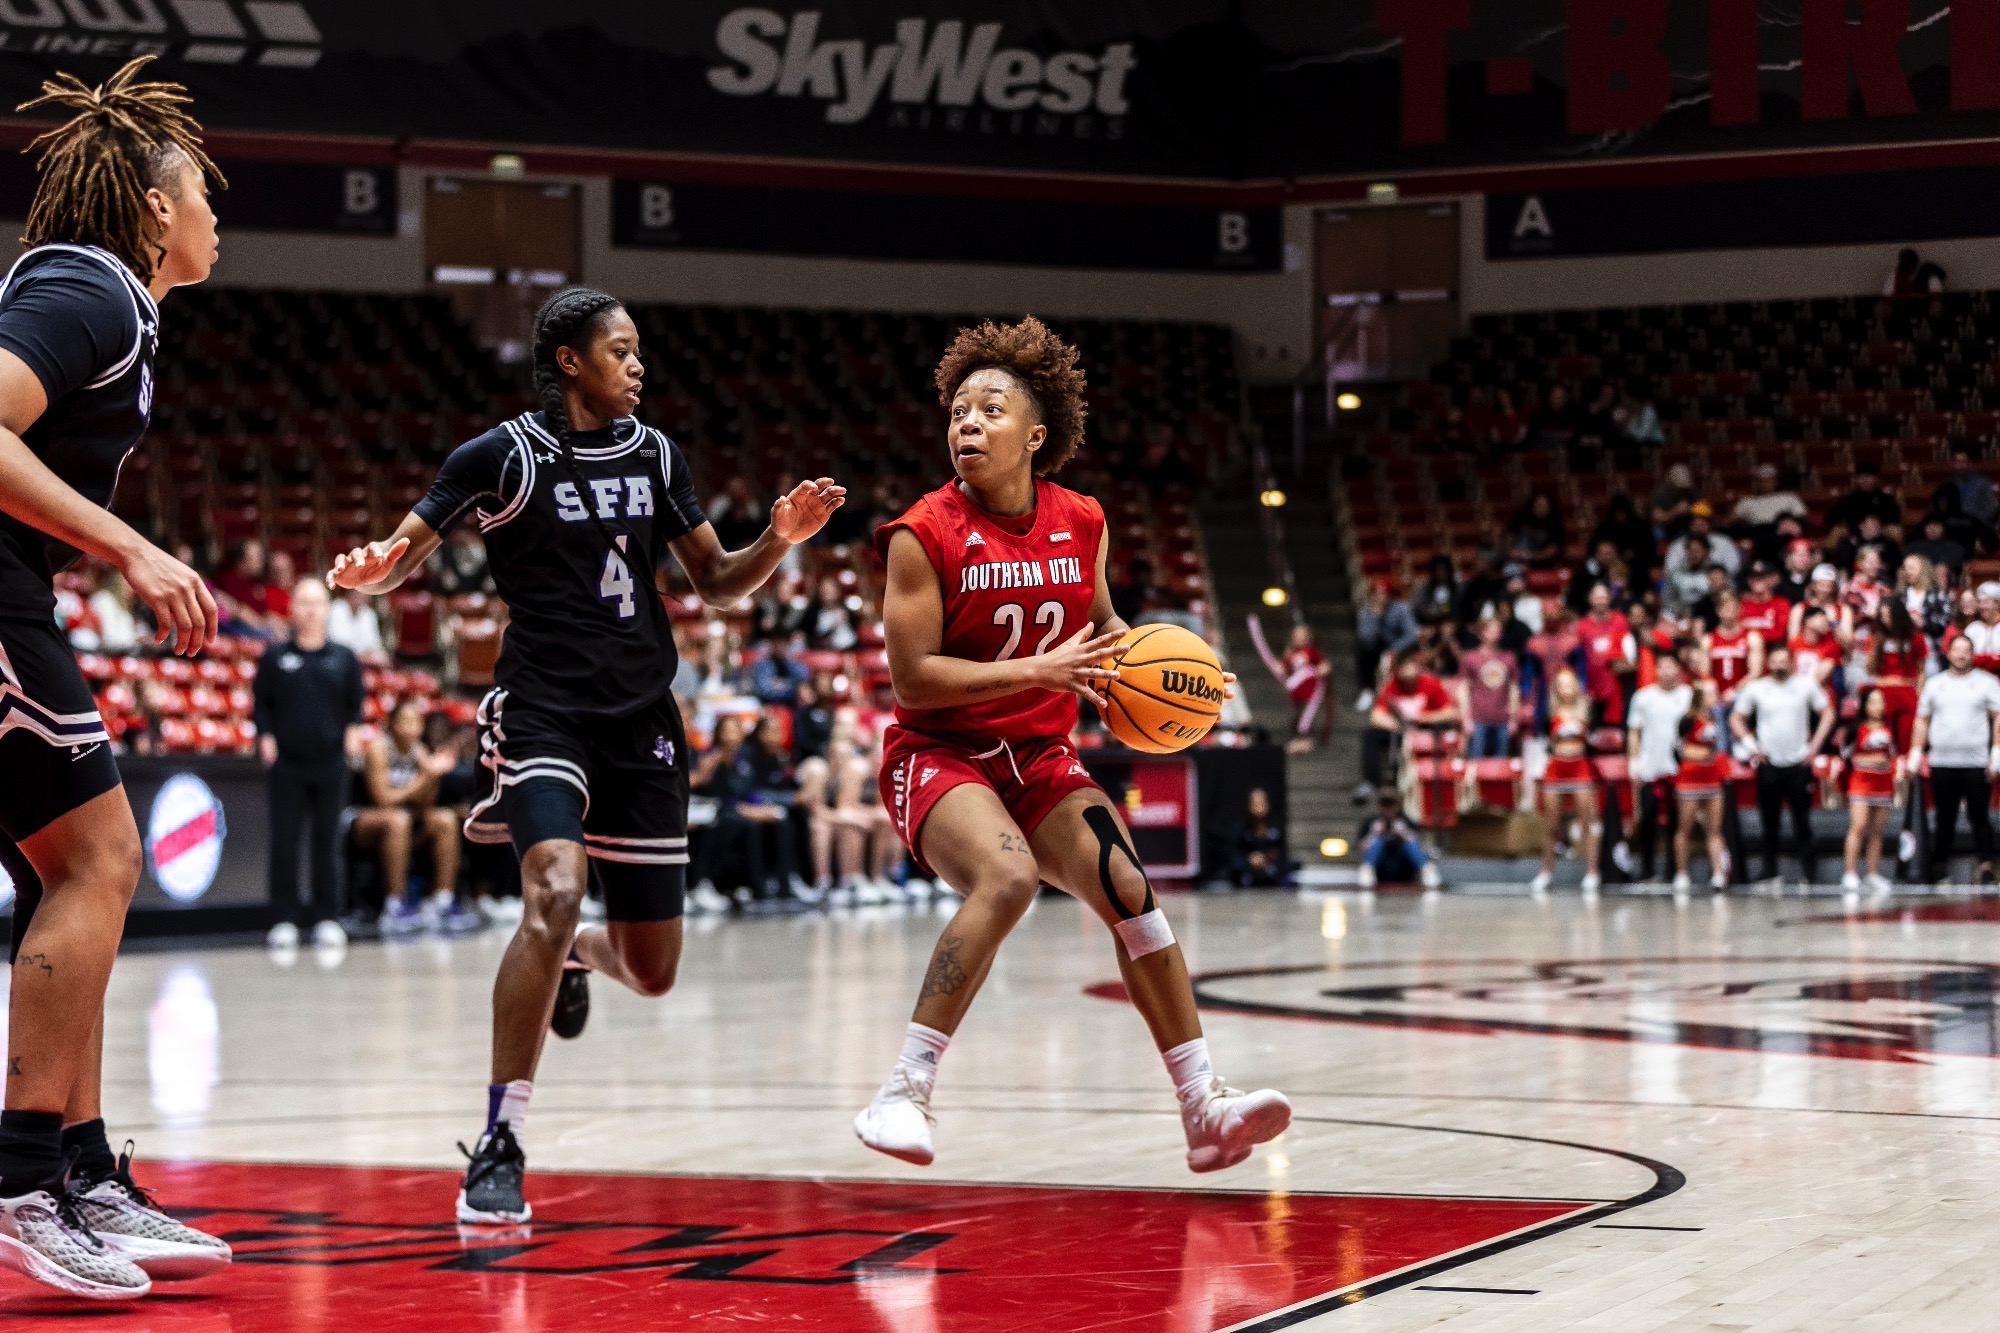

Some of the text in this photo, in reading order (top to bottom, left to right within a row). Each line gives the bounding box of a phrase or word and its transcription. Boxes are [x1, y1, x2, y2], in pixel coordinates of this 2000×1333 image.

[705, 7, 1139, 125] SkyWest
[344, 170, 379, 214] B
[640, 185, 675, 229] B
[1217, 210, 1250, 253] B
[1513, 196, 1553, 237] A
[553, 475, 655, 522] SFA
[599, 532, 636, 619] 4
[960, 561, 1045, 593] SOUTHERN
[992, 600, 1066, 662] 22
[1161, 668, 1223, 705] Wilson
